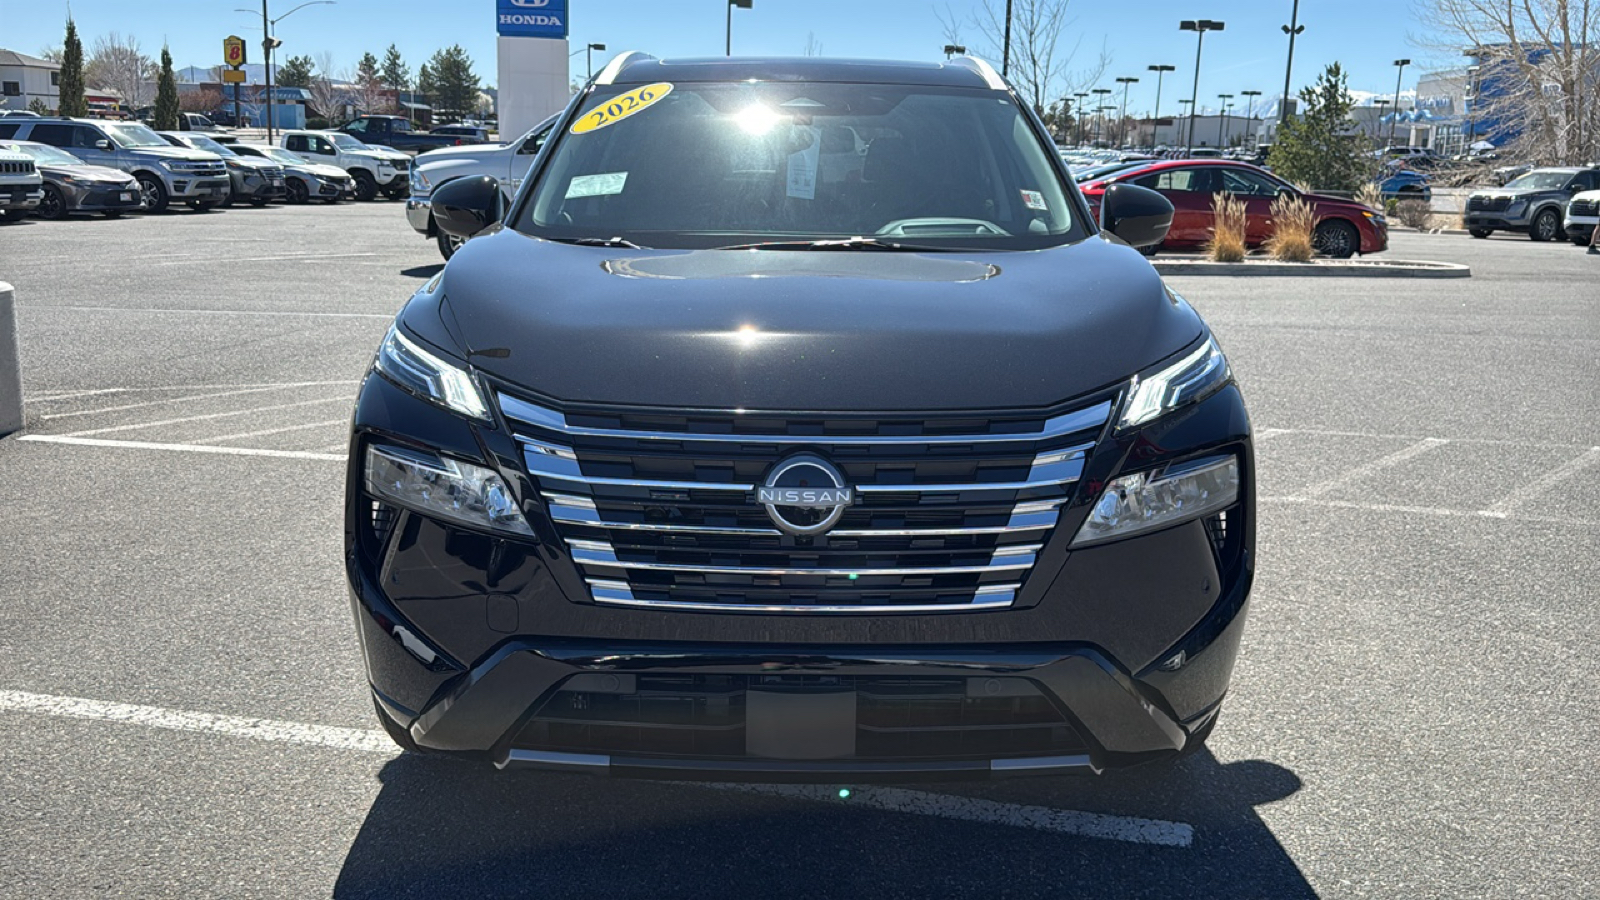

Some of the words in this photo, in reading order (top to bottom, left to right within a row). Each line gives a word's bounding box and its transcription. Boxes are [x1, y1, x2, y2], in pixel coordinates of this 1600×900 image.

[499, 14, 563, 26] HONDA
[229, 45, 240, 60] 8
[590, 87, 655, 127] 2026
[760, 489, 850, 502] NISSAN
